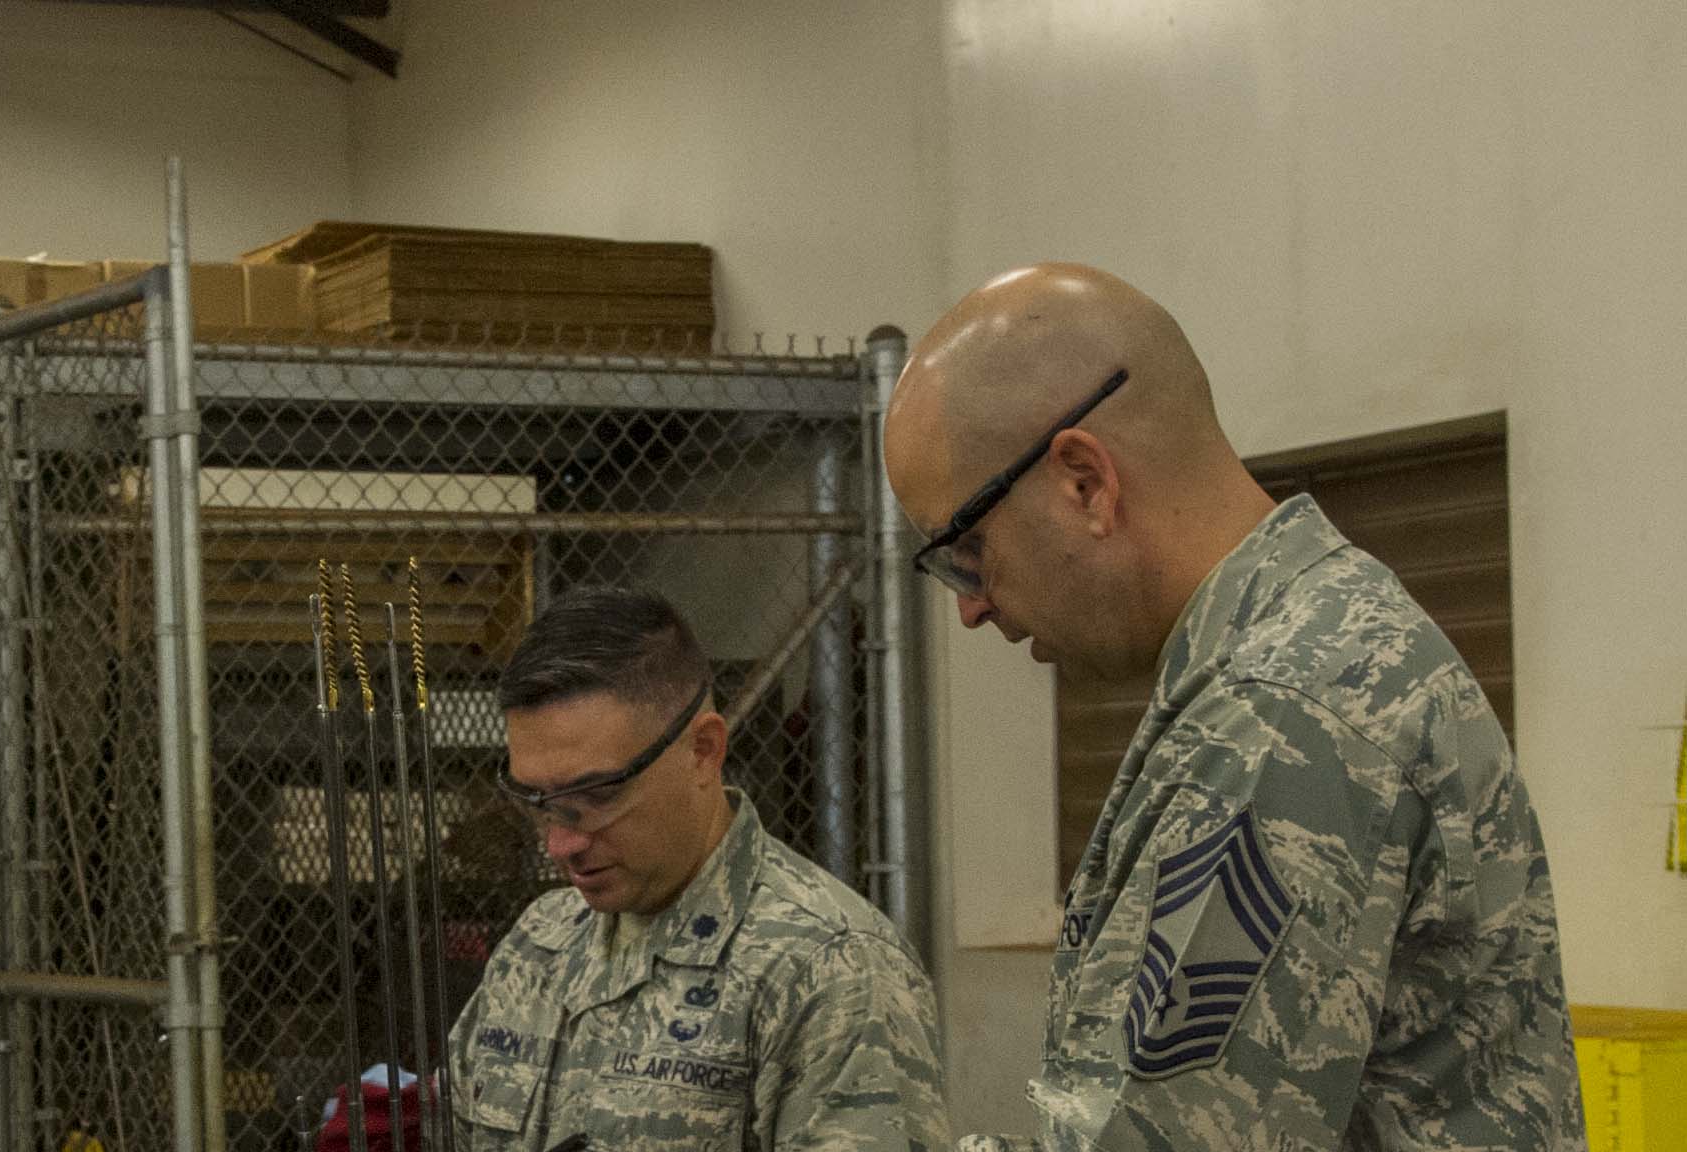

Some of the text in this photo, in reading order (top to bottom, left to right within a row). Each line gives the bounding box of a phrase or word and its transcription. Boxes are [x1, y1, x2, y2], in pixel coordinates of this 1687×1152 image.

[614, 1051, 733, 1090] U.S. AIR FORCE
